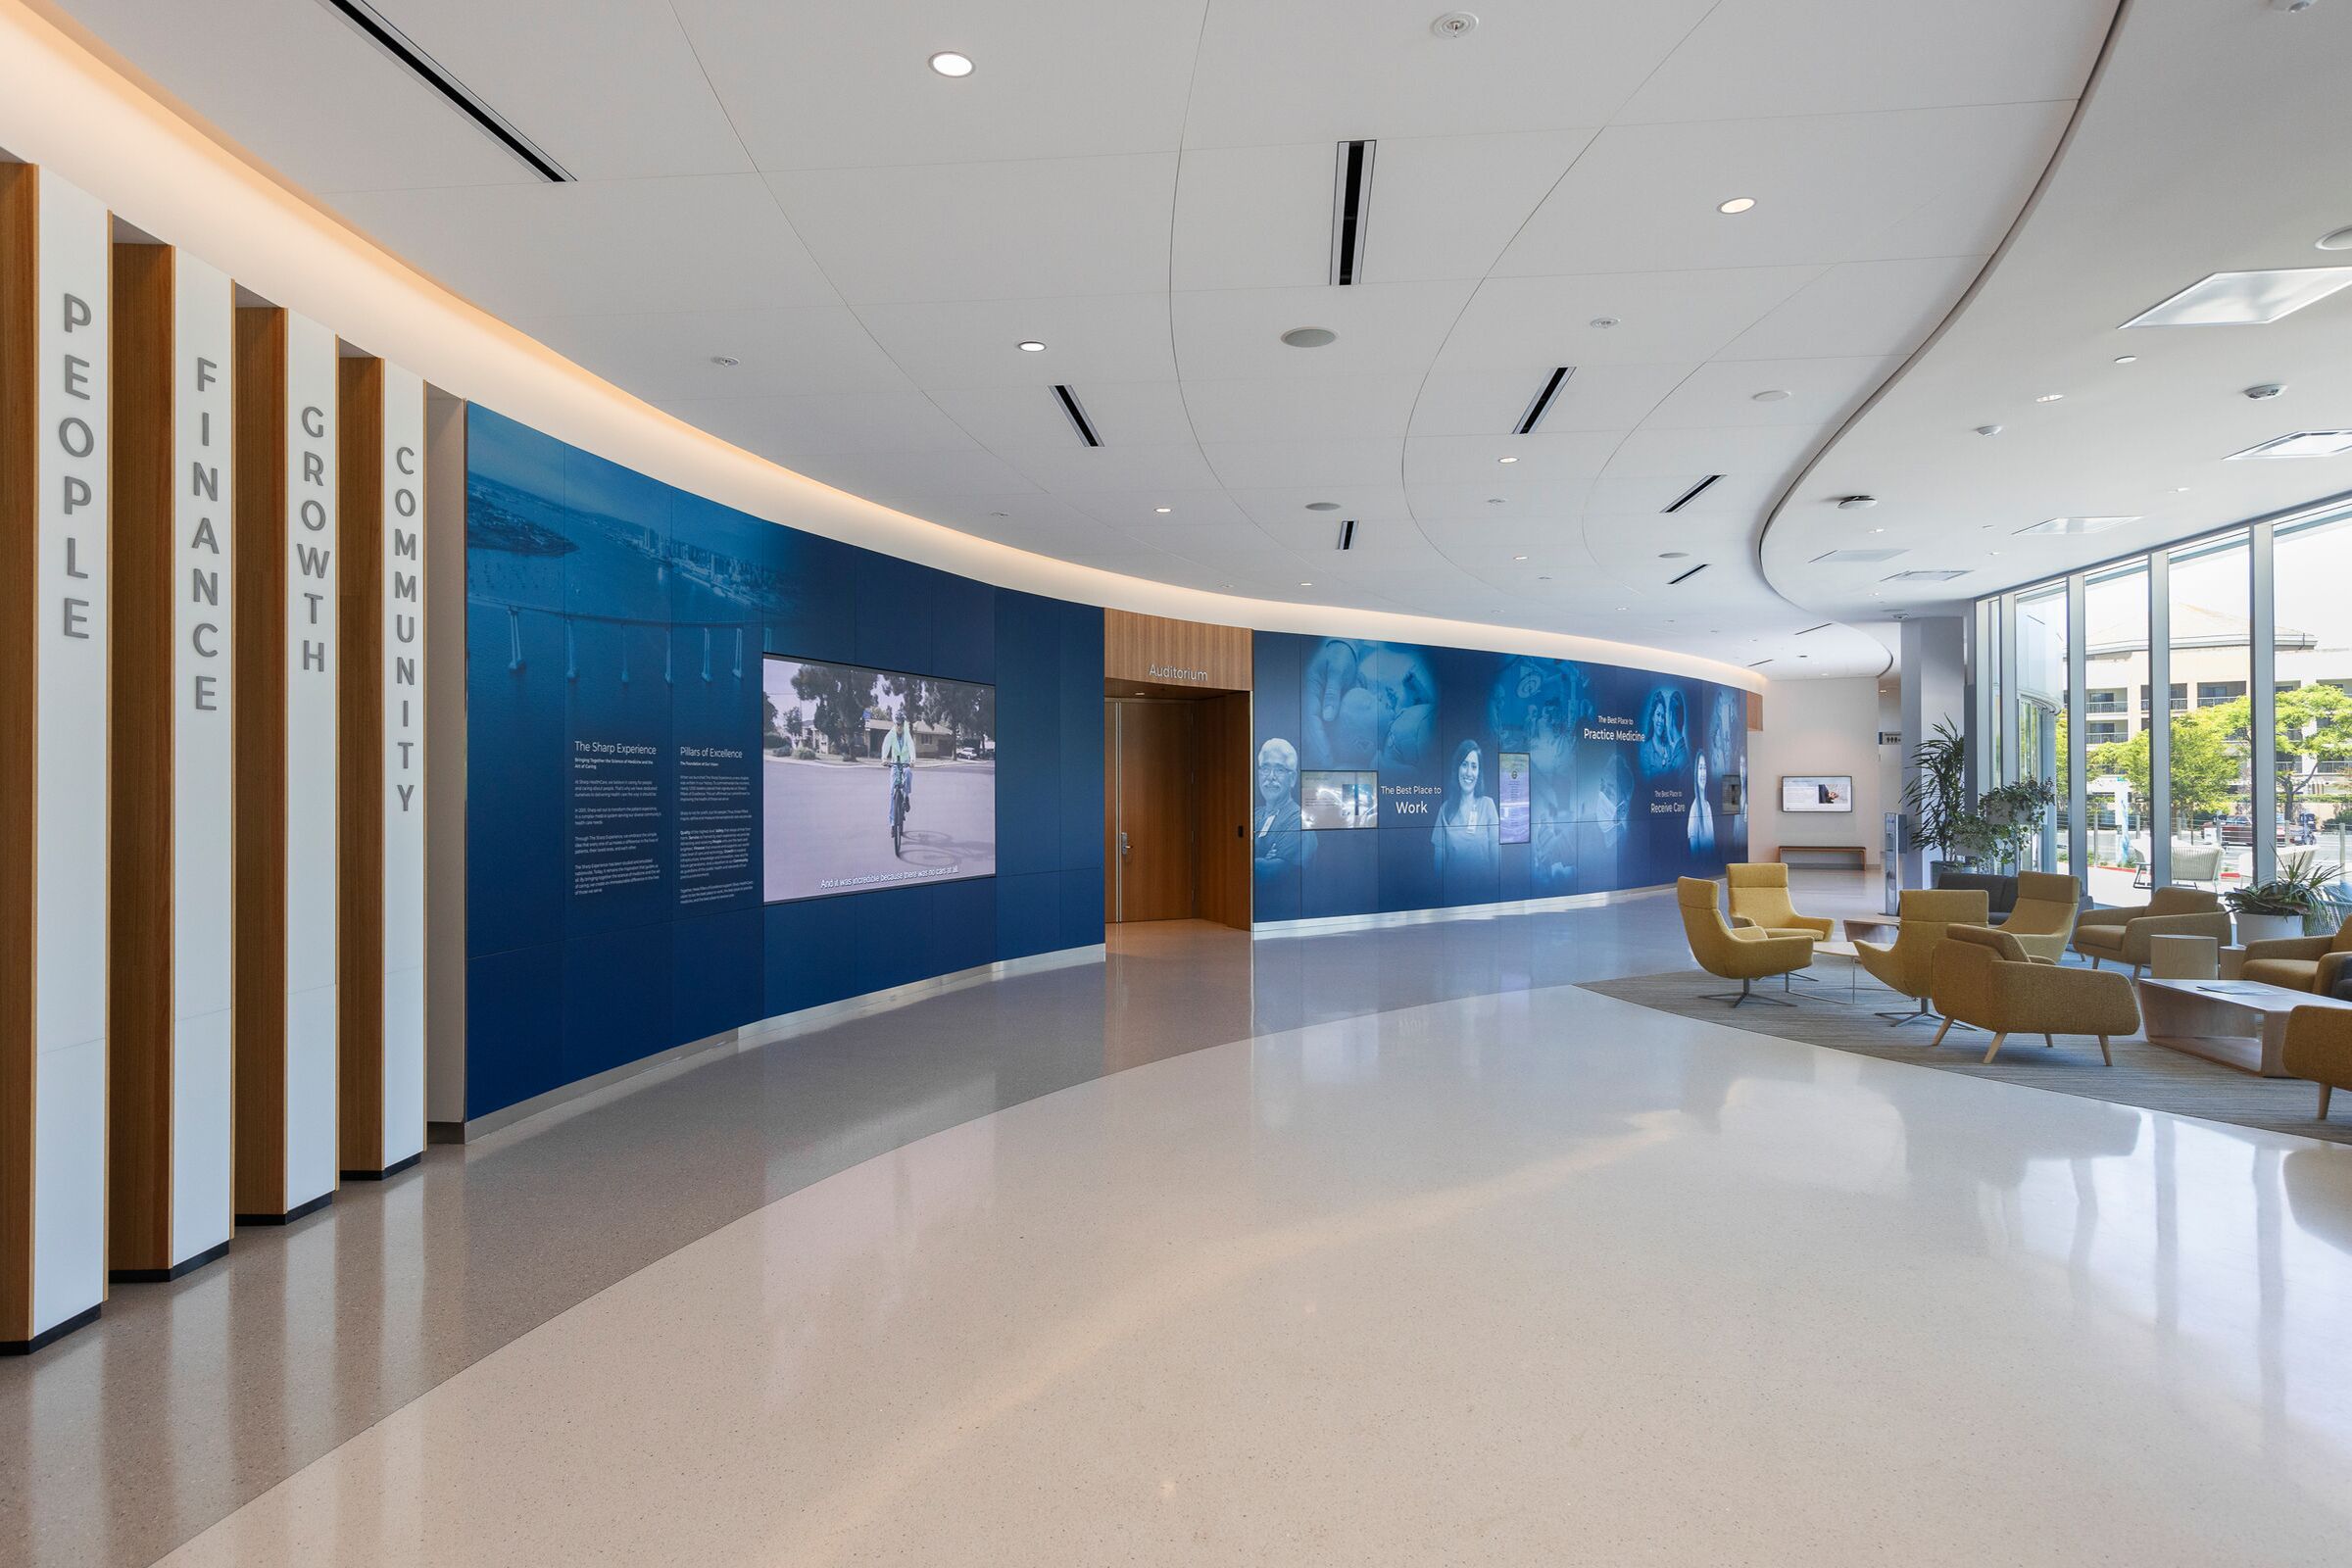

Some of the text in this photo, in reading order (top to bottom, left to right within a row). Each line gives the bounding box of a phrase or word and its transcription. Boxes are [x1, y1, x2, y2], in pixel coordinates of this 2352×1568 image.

[59, 292, 95, 639] PEOPLE
[191, 357, 220, 711] FINANCE
[297, 406, 330, 672] GROWTH
[394, 446, 416, 811] COMMUNITY
[1149, 664, 1208, 681] Auditorium
[1584, 728, 1645, 742] Practice Medicine
[574, 741, 657, 756] The Sharp Experience
[680, 746, 743, 759] Pillars of Excellence
[1381, 786, 1395, 794] The
[1396, 786, 1412, 794] Best
[1413, 786, 1433, 794] Place
[1396, 801, 1428, 814] Work
[1651, 802, 1685, 813] Receive Care
[821, 879, 833, 888] And
[854, 875, 880, 885] incredible
[881, 872, 903, 882] because
